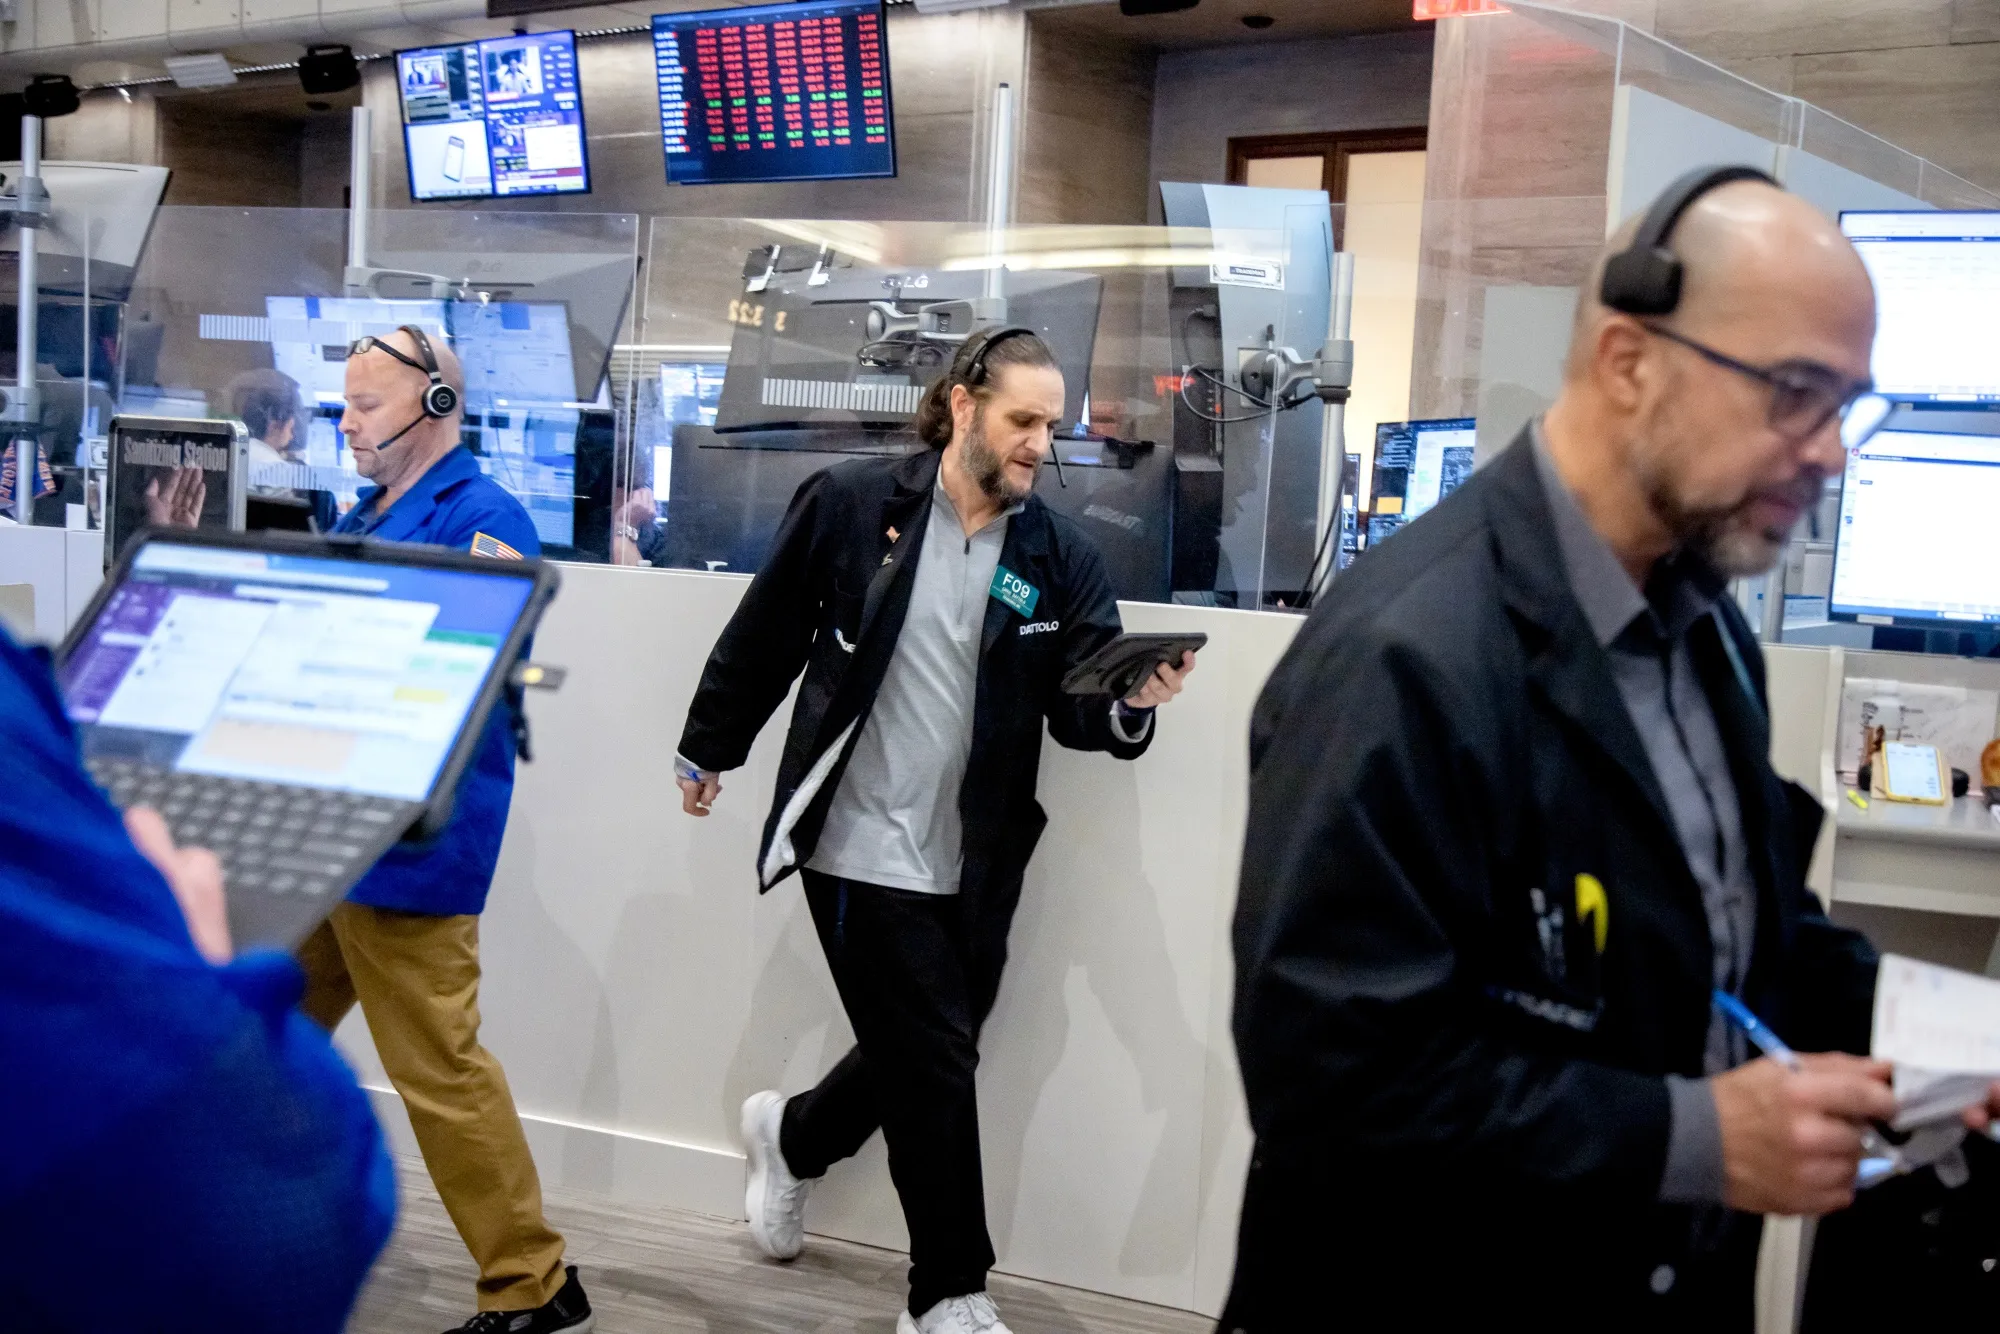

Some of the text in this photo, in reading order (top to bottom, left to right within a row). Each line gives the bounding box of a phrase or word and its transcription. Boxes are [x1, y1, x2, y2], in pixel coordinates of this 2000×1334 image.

[904, 274, 929, 288] LG
[124, 436, 228, 471] Sanitizing Station
[1002, 573, 1031, 598] F09
[1020, 621, 1059, 635] DATTOLO
